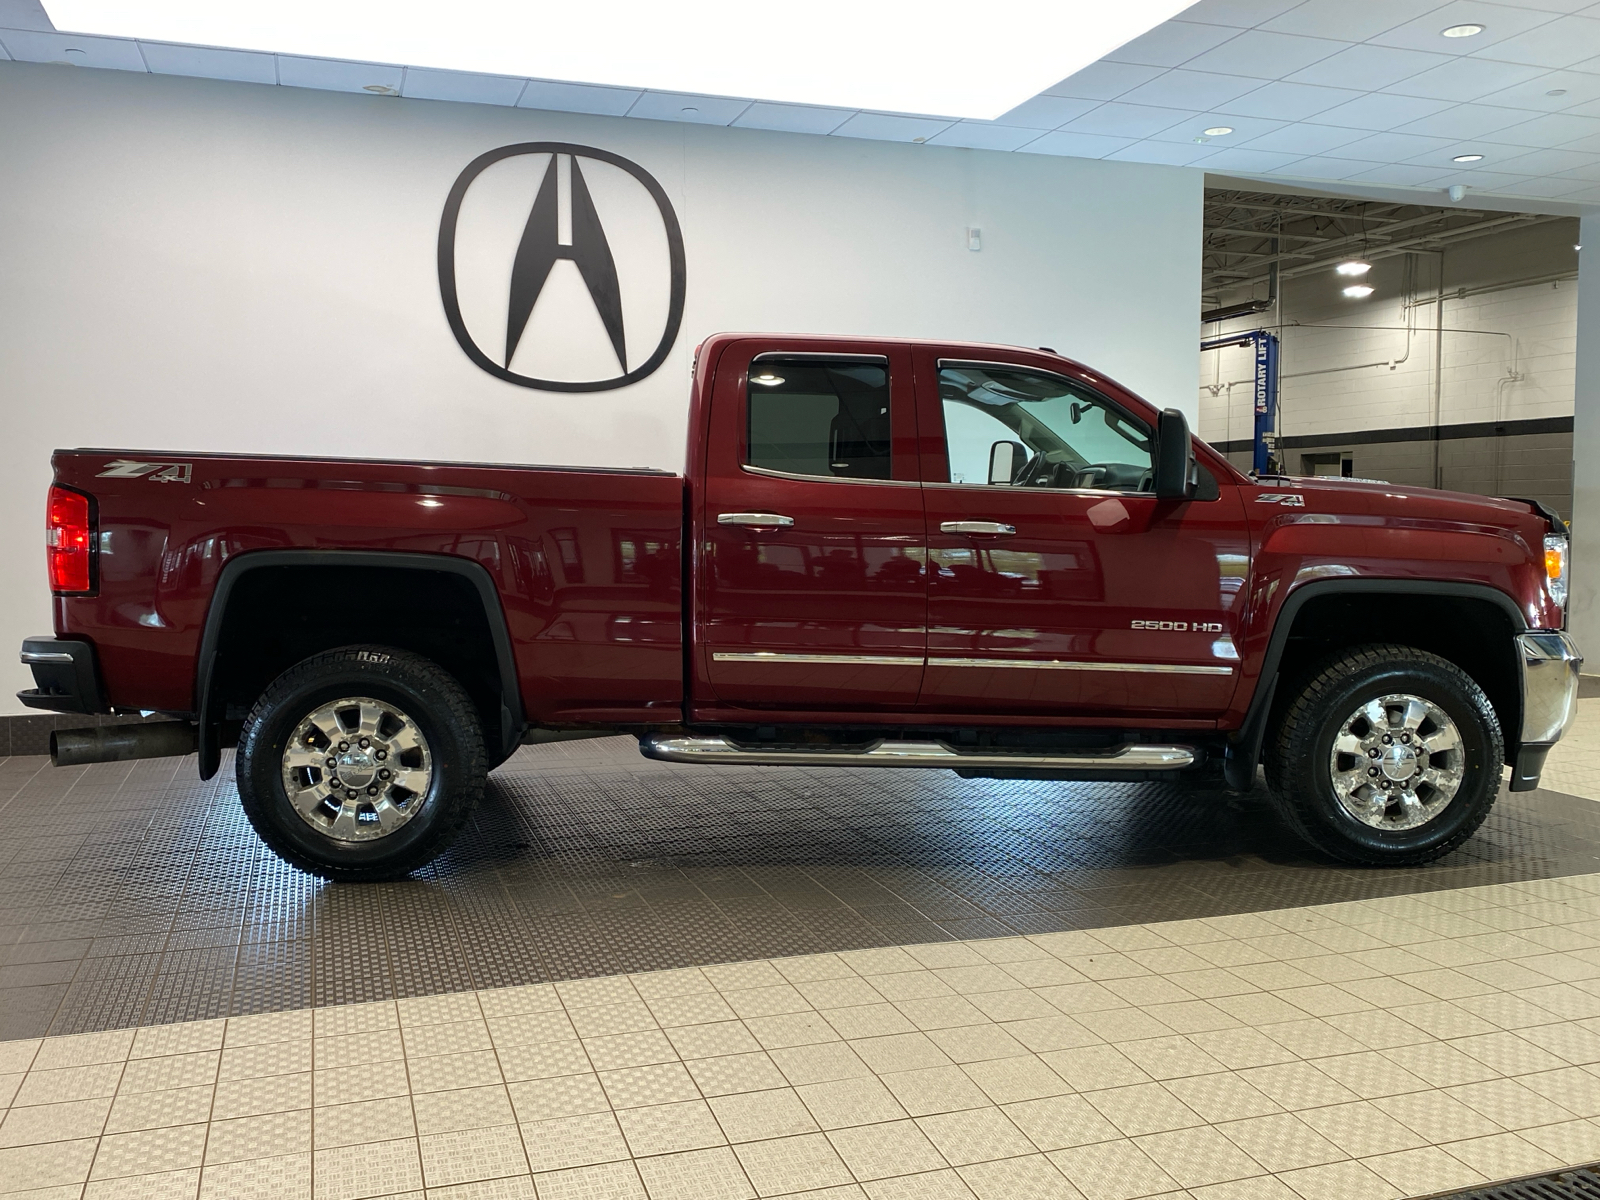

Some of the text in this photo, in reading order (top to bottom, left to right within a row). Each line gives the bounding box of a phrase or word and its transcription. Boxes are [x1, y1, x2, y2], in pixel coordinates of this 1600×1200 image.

[1257, 338, 1267, 406] ROTARY LIFT
[1131, 620, 1223, 632] 2500 HD
